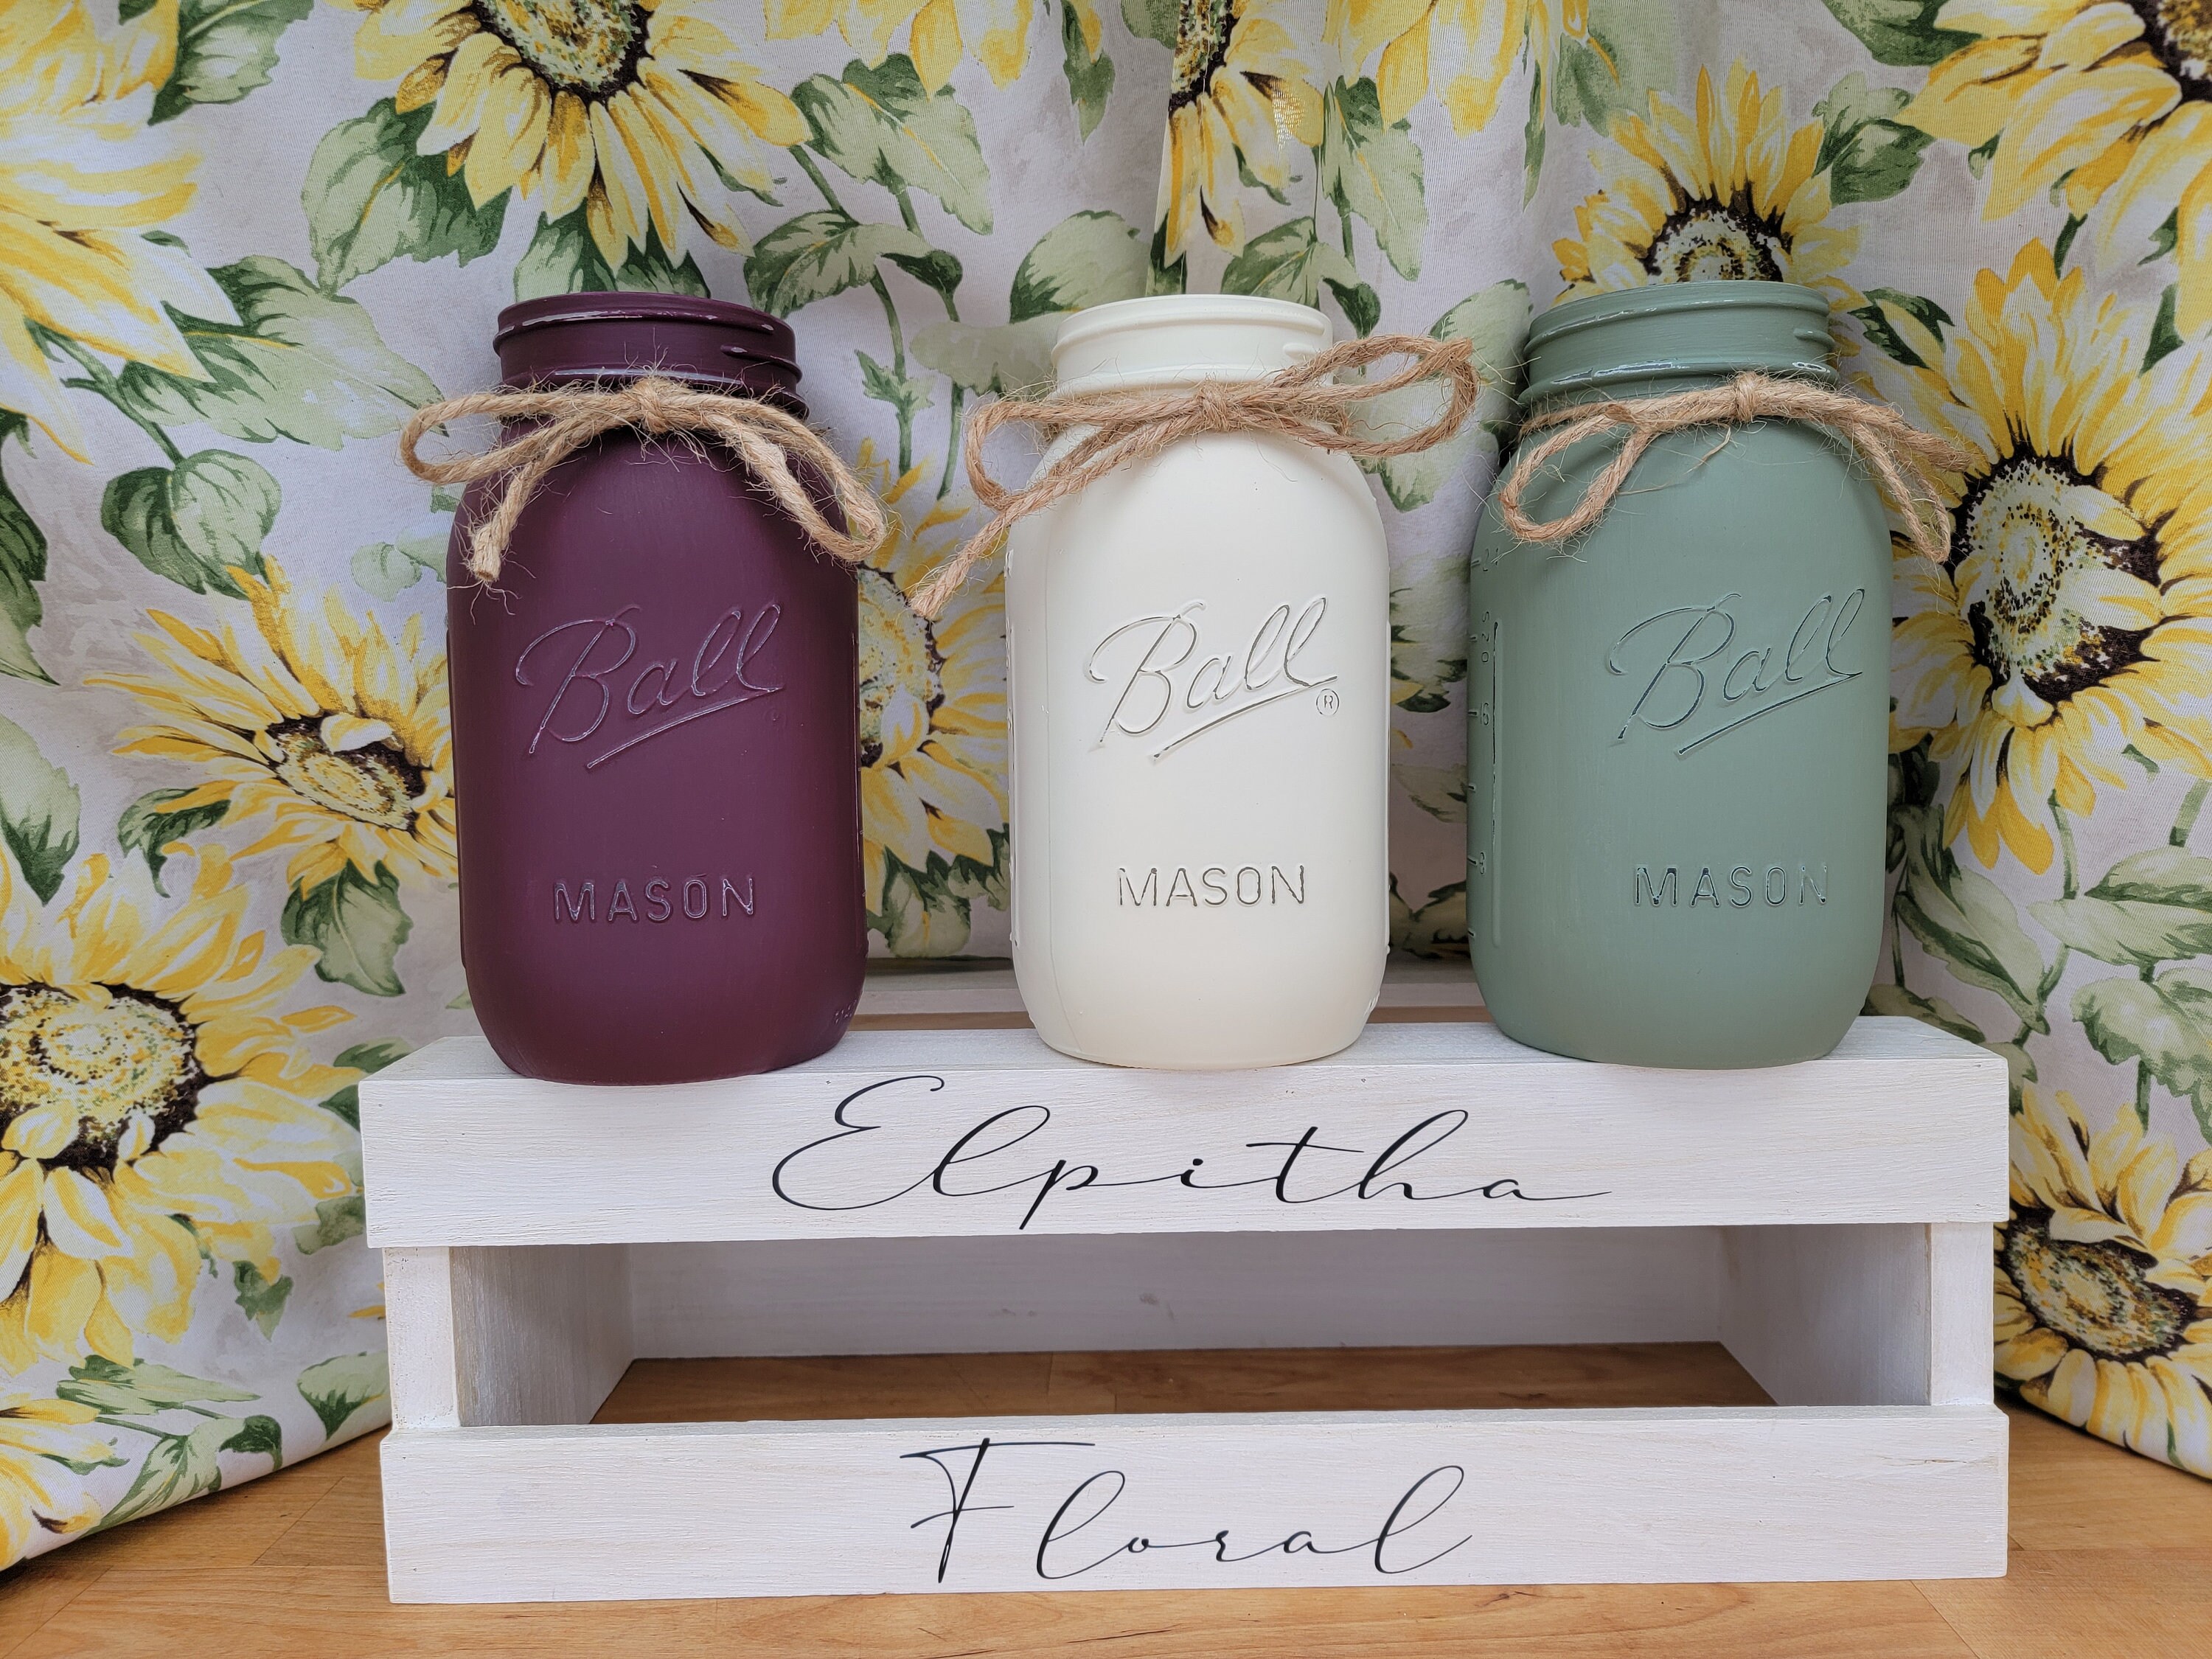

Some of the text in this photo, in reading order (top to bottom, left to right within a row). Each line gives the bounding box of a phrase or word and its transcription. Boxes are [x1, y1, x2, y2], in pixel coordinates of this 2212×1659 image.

[515, 603, 785, 769] Ball
[1085, 597, 1338, 762] Ball
[1608, 588, 1864, 757] Ball
[554, 877, 756, 922] MASON
[1117, 864, 1306, 908] MASON
[1635, 866, 1829, 907] MASON
[772, 1074, 1612, 1231] Elpitha
[900, 1436, 1472, 1585] Floral
